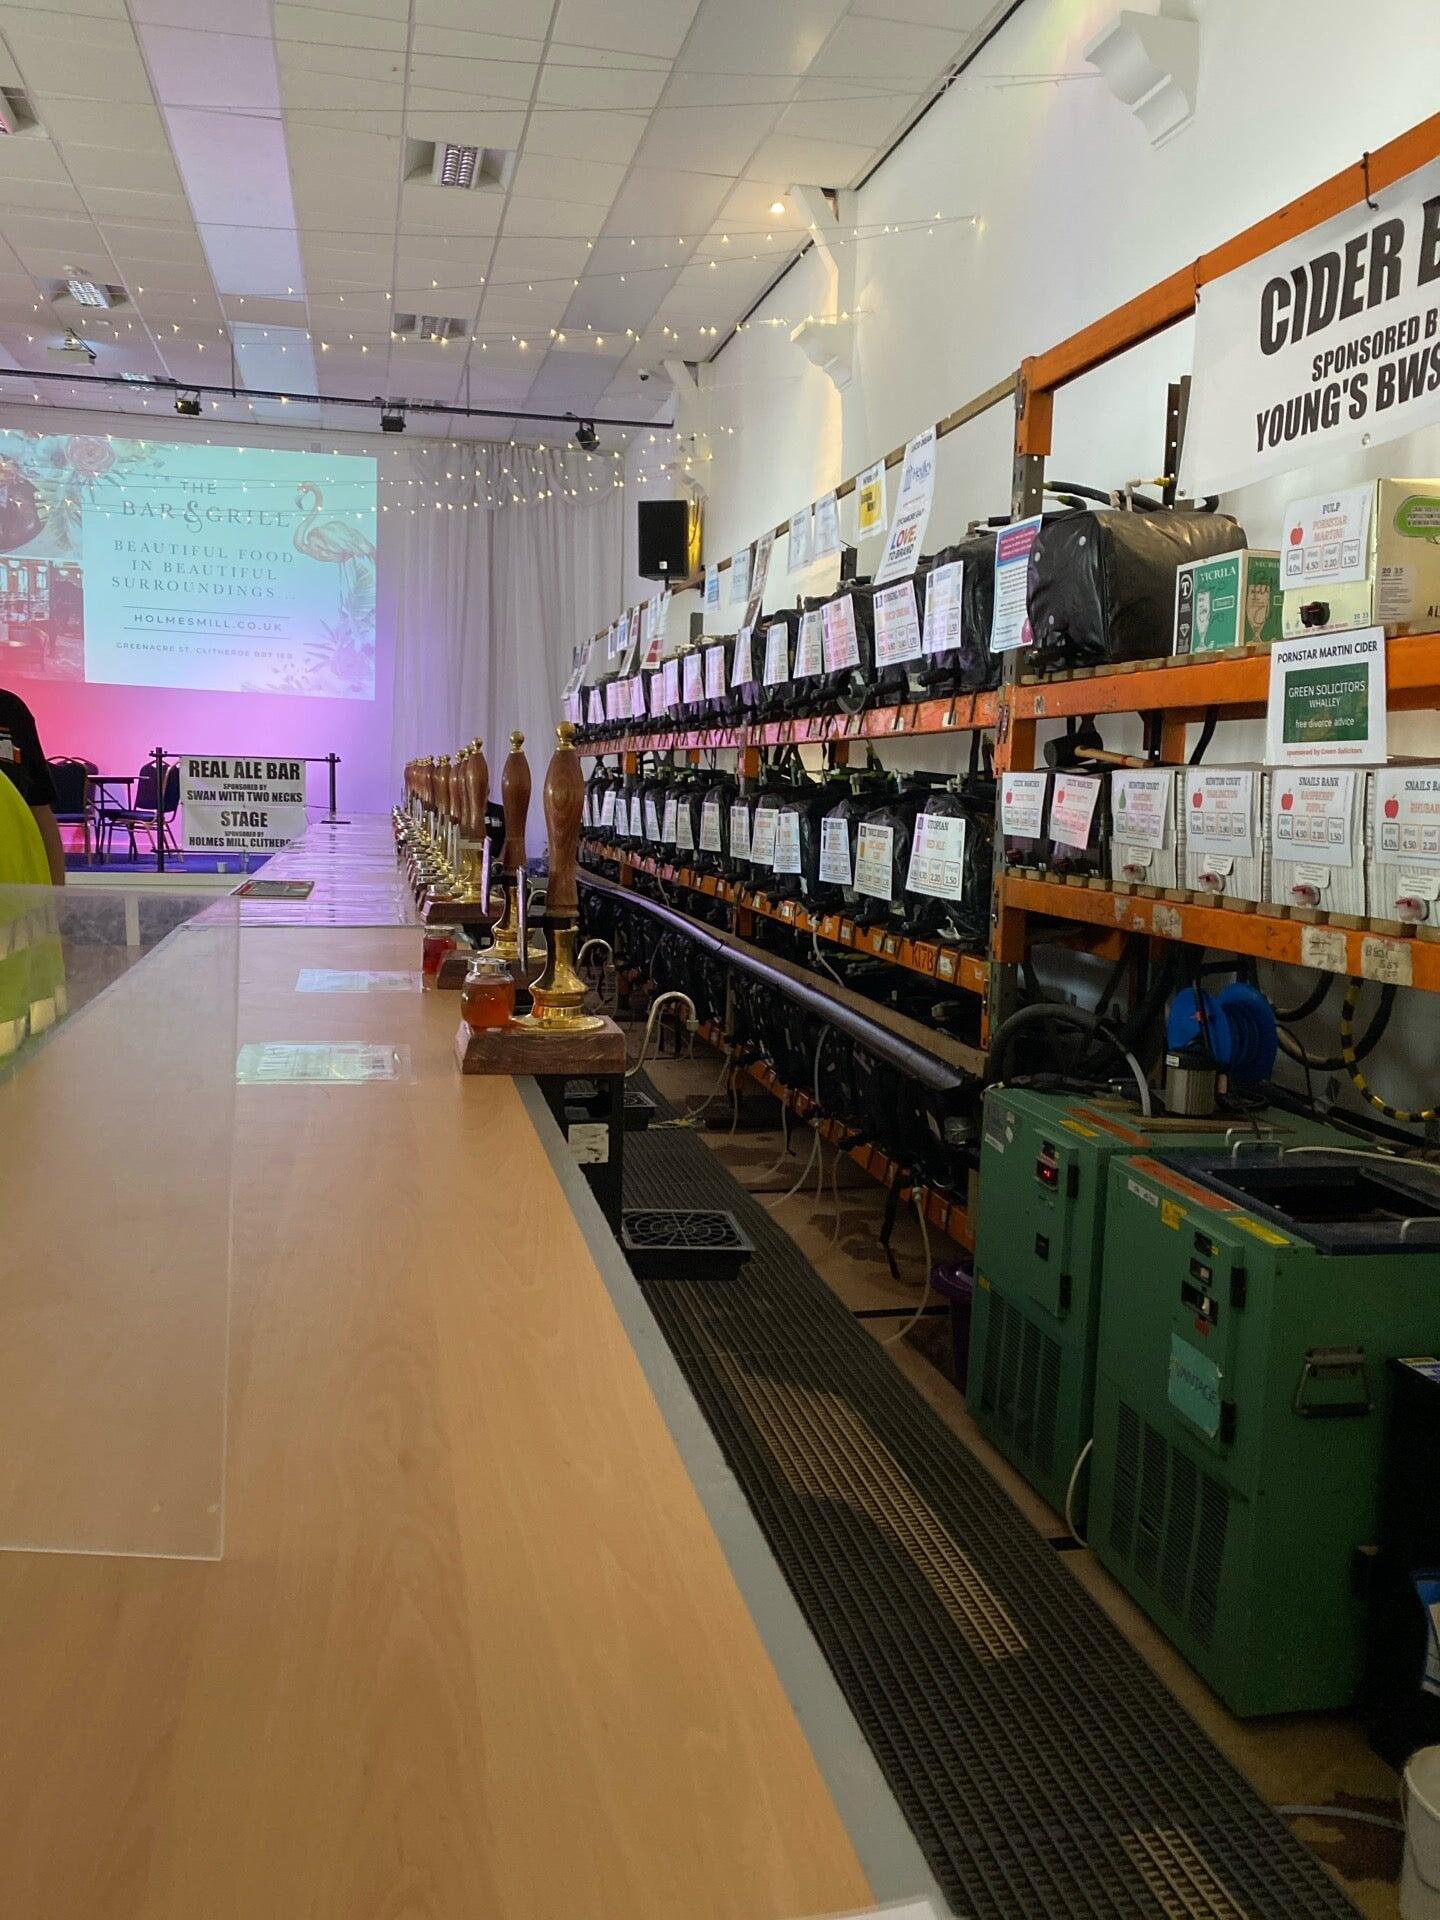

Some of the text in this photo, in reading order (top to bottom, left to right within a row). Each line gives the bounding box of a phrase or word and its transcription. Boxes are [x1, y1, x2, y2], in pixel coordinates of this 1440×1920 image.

[1260, 218, 1404, 356] CIDER
[1311, 315, 1420, 382] SPONSORED
[1257, 372, 1369, 453] YOUNG'S
[180, 481, 217, 495] THE
[1322, 502, 1341, 514] PULP
[114, 539, 294, 564] BEAUTIFUL FOOD
[131, 559, 278, 581] IN BEAUTIFUL
[1200, 566, 1236, 581] VICRILA
[134, 614, 283, 632] HOLMESMILL.CO.UK
[116, 641, 175, 652] GREENACRE
[1277, 640, 1378, 663] PORNSTAR MARTINI CIDER
[1288, 680, 1366, 698] GREEN SOLICITORS
[1309, 697, 1341, 708] WHALLEY
[1308, 718, 1333, 728] divorce
[189, 760, 300, 780] REAL ALE BAR
[1299, 777, 1340, 787] SNAILS BANK
[1405, 780, 1431, 791] SNAILS
[187, 790, 303, 802] SWAN WITH TWO NECKS
[220, 811, 268, 828] STAGE
[189, 836, 224, 847] HOLMES
[226, 837, 249, 848] MILL,
[1403, 840, 1417, 849] 4.50
[1423, 841, 1437, 851] 2.20
